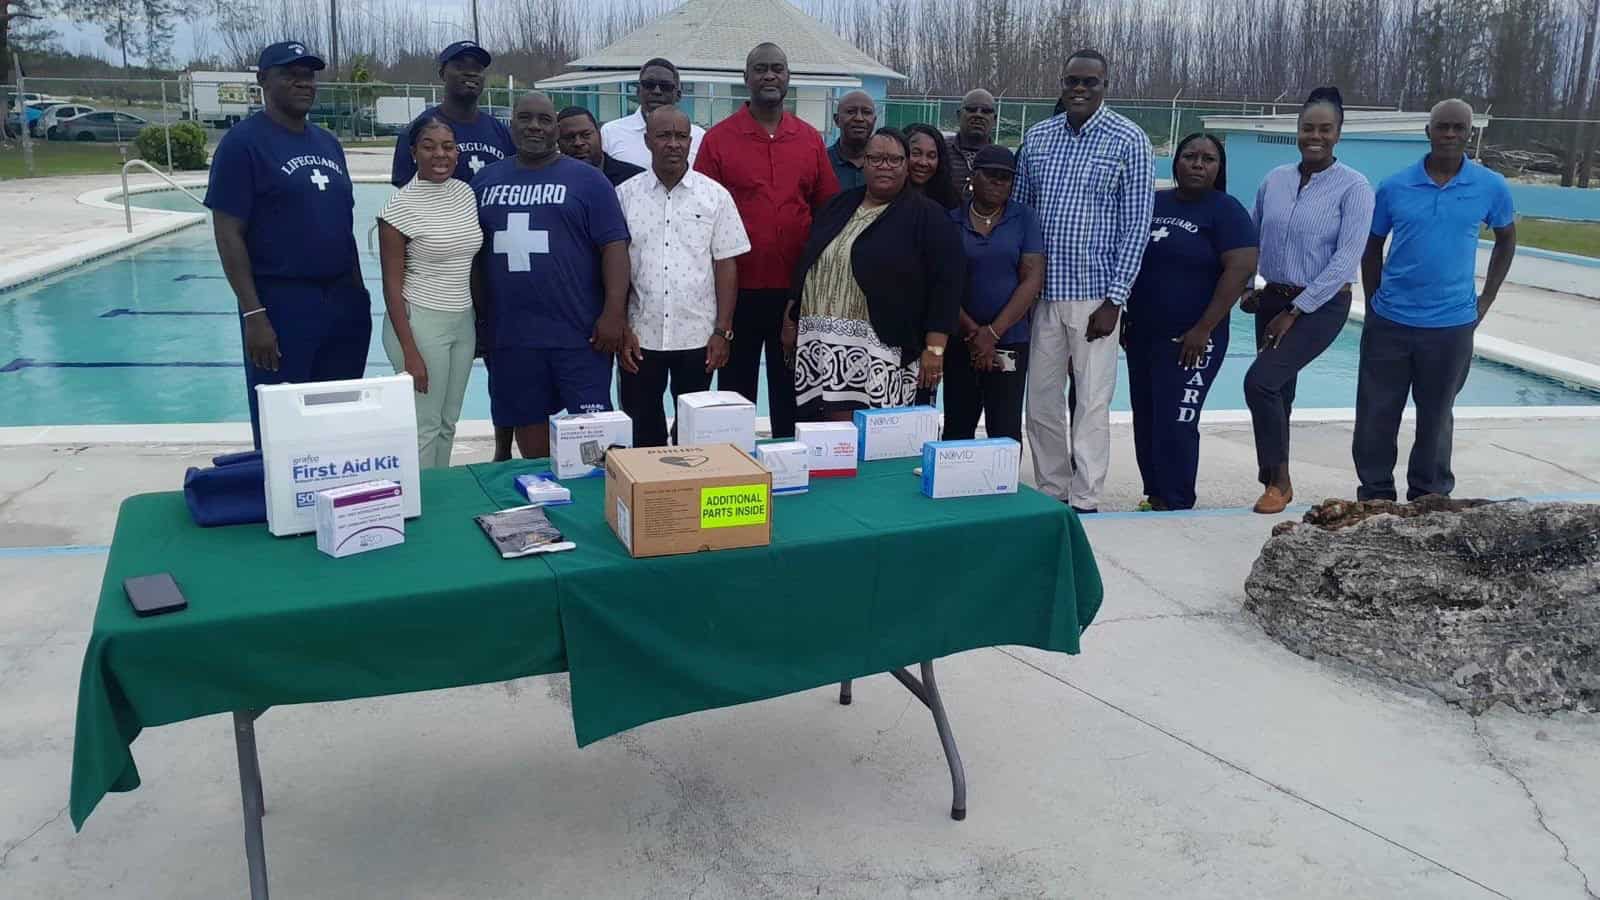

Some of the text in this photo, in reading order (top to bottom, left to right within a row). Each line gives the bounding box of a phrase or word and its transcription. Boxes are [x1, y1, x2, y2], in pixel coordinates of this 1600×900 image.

[481, 184, 567, 207] LIFEGUARD
[293, 463, 337, 479] First
[342, 458, 371, 474] Aid
[374, 455, 399, 471] Kit
[297, 494, 314, 504] 50
[706, 493, 762, 506] ADDITIONAL
[702, 504, 765, 518] PARTS INSIDE
